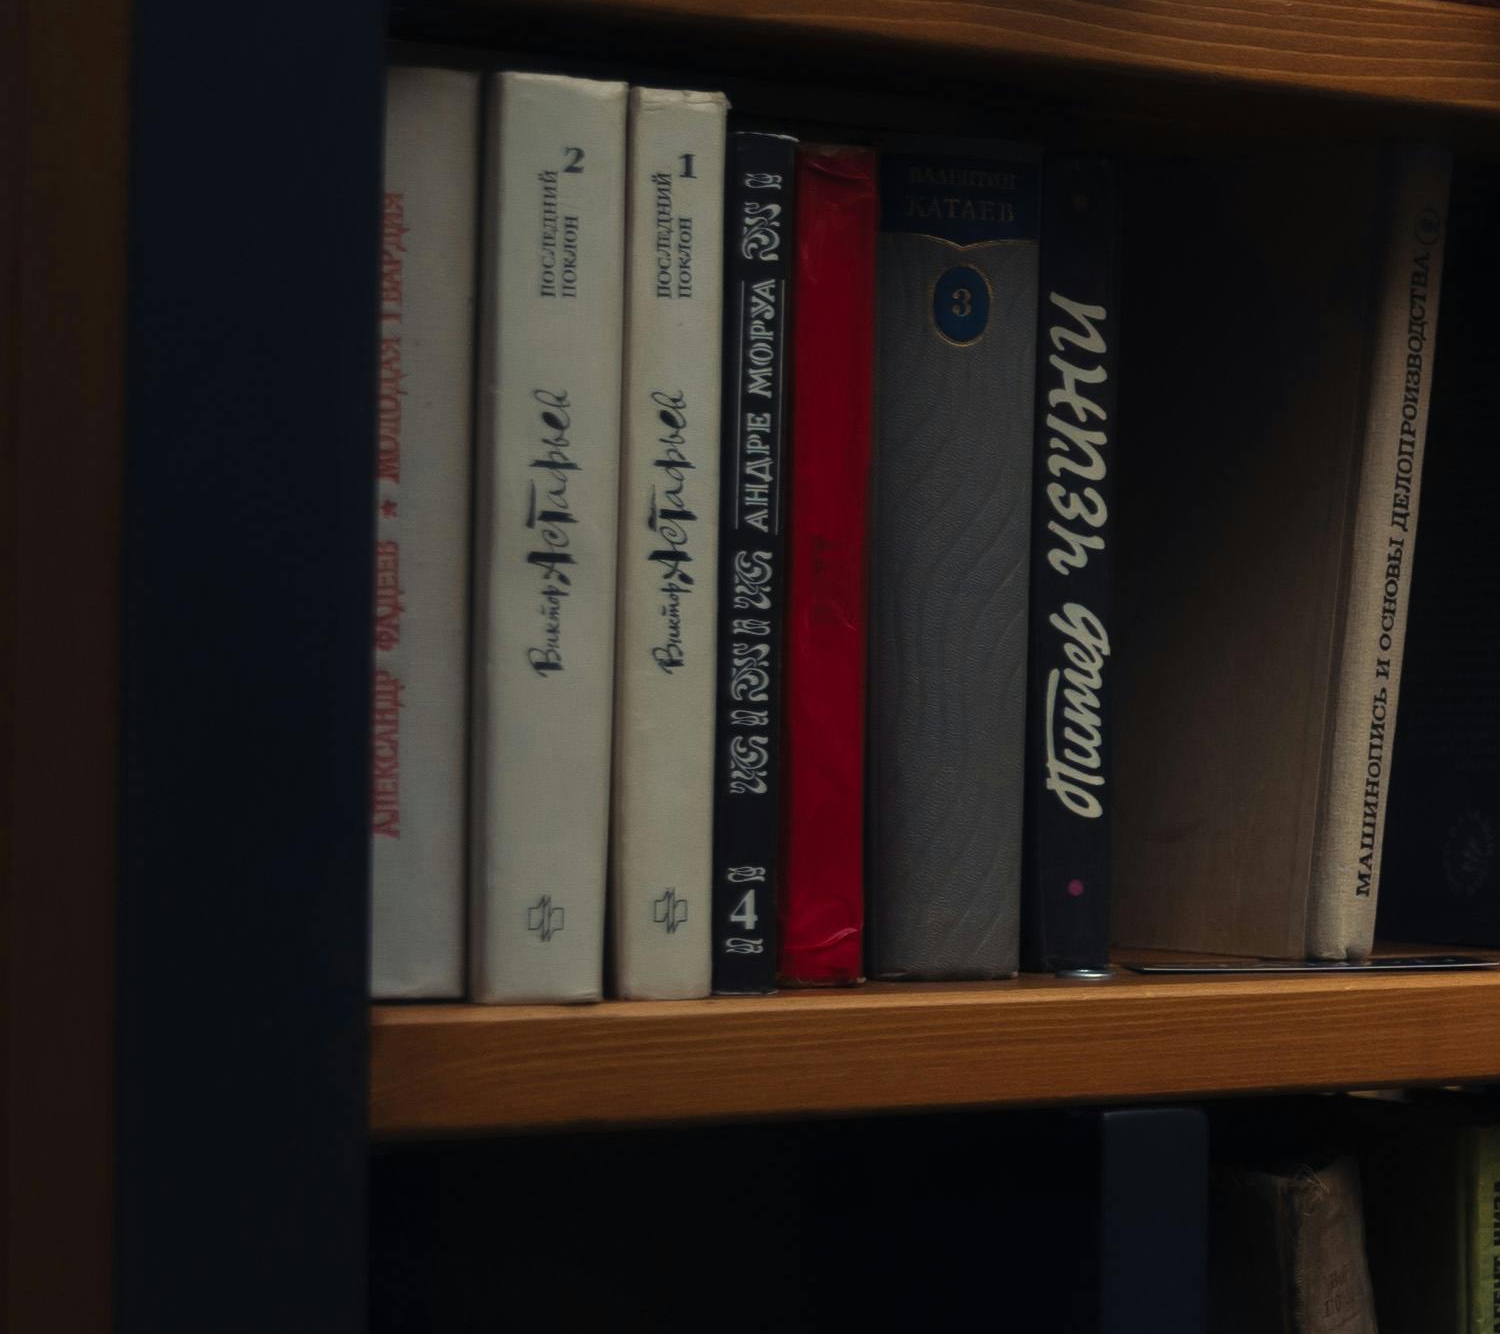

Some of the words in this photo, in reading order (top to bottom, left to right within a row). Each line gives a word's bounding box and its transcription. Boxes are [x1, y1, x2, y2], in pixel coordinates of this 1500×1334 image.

[564, 148, 585, 174] 2
[678, 154, 697, 179] 1
[540, 170, 559, 300] ПОСЛЕДНИЙ
[655, 172, 673, 300] ПОСЛЕДНИЙ
[905, 195, 1015, 221] КАТАЕВ
[561, 216, 578, 299] ПОКЛОН
[676, 218, 693, 299] ПОКЛОН
[747, 278, 777, 397] МОРУА
[951, 288, 972, 316] 3
[1391, 250, 1432, 529] ДЕЛОПРОИЗВОДСТВА
[743, 412, 773, 533] АНДРЕ
[1379, 538, 1406, 650] ОСНОВЫ
[1377, 658, 1393, 678] И
[1354, 686, 1391, 897] МАШИНОПИСЬ
[728, 894, 760, 932] 4
